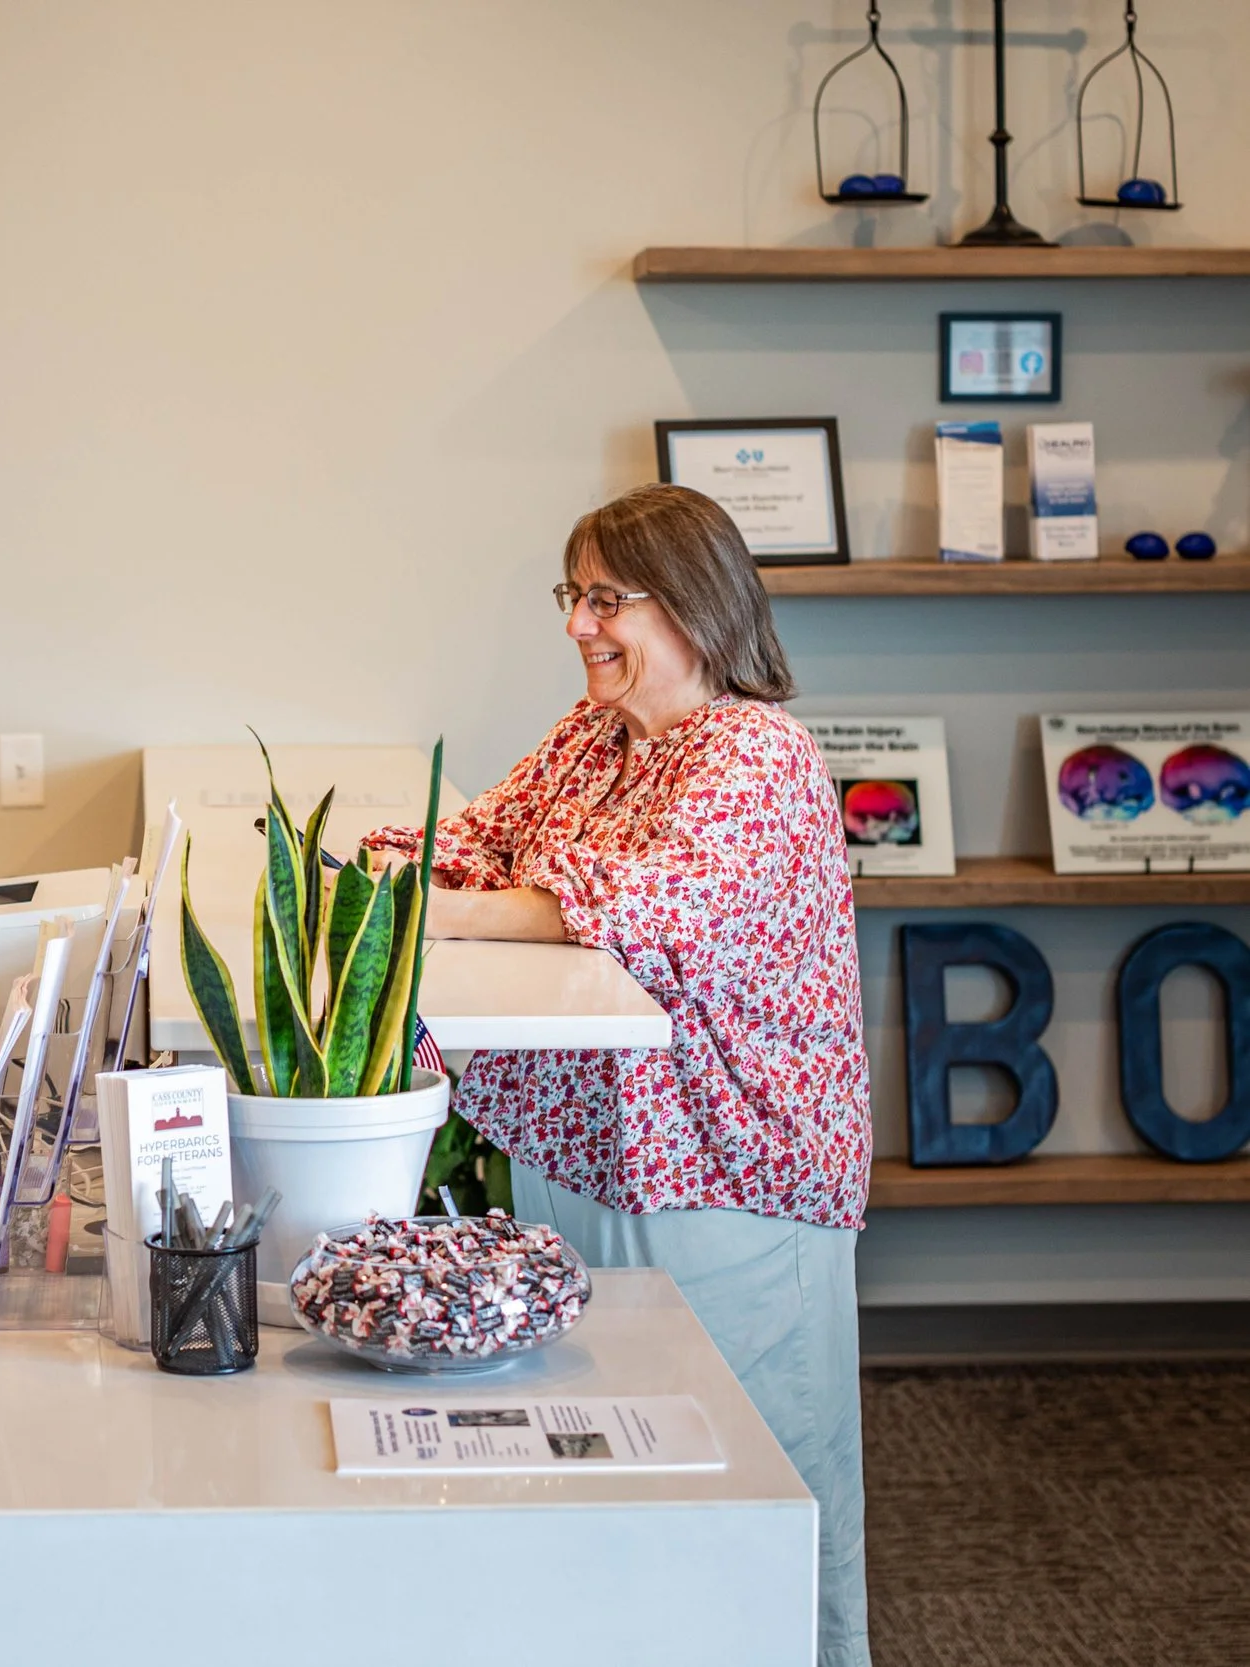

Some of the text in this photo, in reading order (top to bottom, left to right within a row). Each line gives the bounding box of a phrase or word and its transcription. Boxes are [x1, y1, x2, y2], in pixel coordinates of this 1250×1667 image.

[816, 725, 829, 735] to
[833, 724, 864, 735] Brain
[1181, 722, 1191, 733] of
[1193, 722, 1210, 733] the
[1212, 721, 1241, 733] Brain
[823, 741, 918, 753] Repair the Brain
[152, 1088, 202, 1102] CASS COUNTY
[139, 1134, 220, 1153] HYPERBARICS
[137, 1154, 161, 1166] FOR
